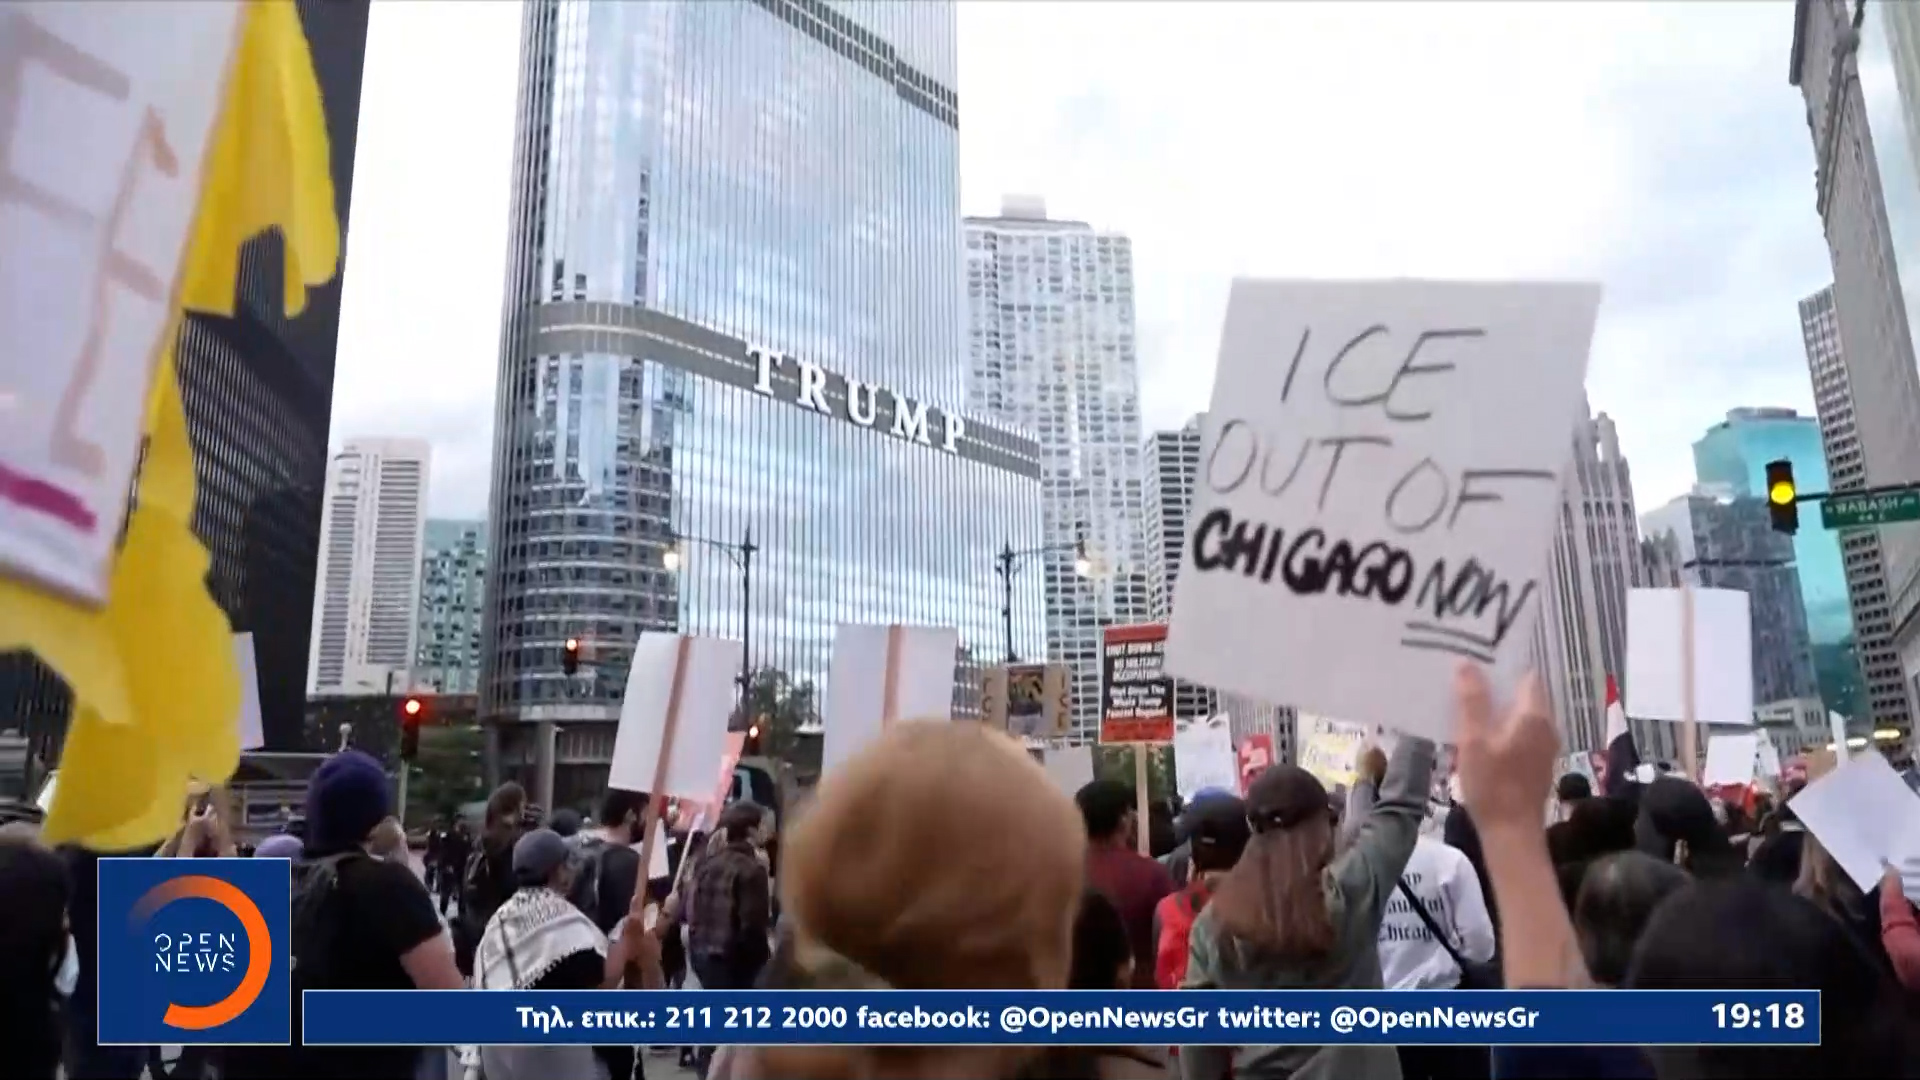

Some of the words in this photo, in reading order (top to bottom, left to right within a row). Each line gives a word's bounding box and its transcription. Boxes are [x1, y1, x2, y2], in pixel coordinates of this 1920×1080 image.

[746, 342, 966, 453] TRUMP
[1281, 323, 1486, 421] ICE
[1207, 418, 1392, 512] OUT
[1385, 457, 1557, 534] OF
[1415, 556, 1537, 648] NOW
